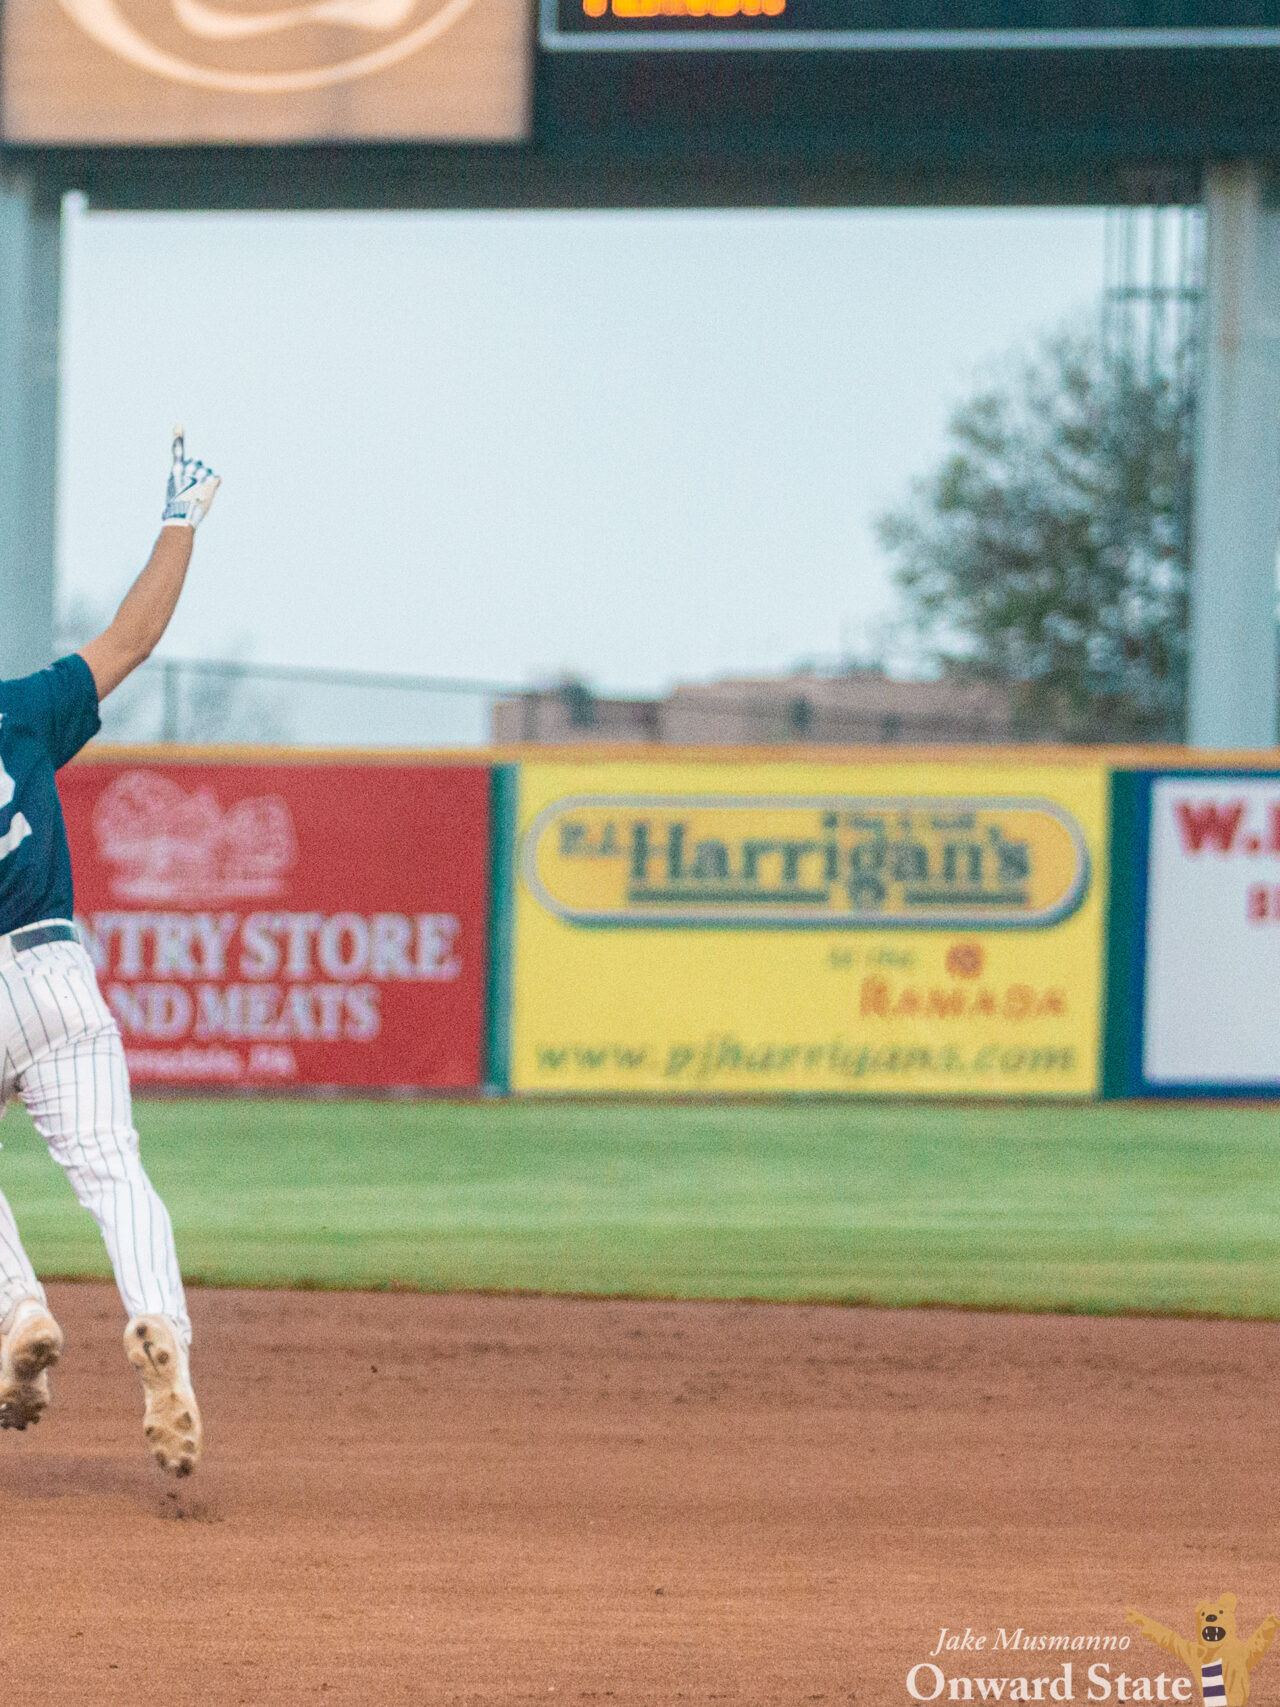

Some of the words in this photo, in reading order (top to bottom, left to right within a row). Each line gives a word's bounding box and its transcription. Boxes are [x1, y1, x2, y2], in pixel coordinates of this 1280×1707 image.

[1173, 800, 1280, 857] W.
[626, 812, 1029, 912] Harrigan's
[239, 911, 462, 981] STORE
[193, 982, 382, 1042] MEATS
